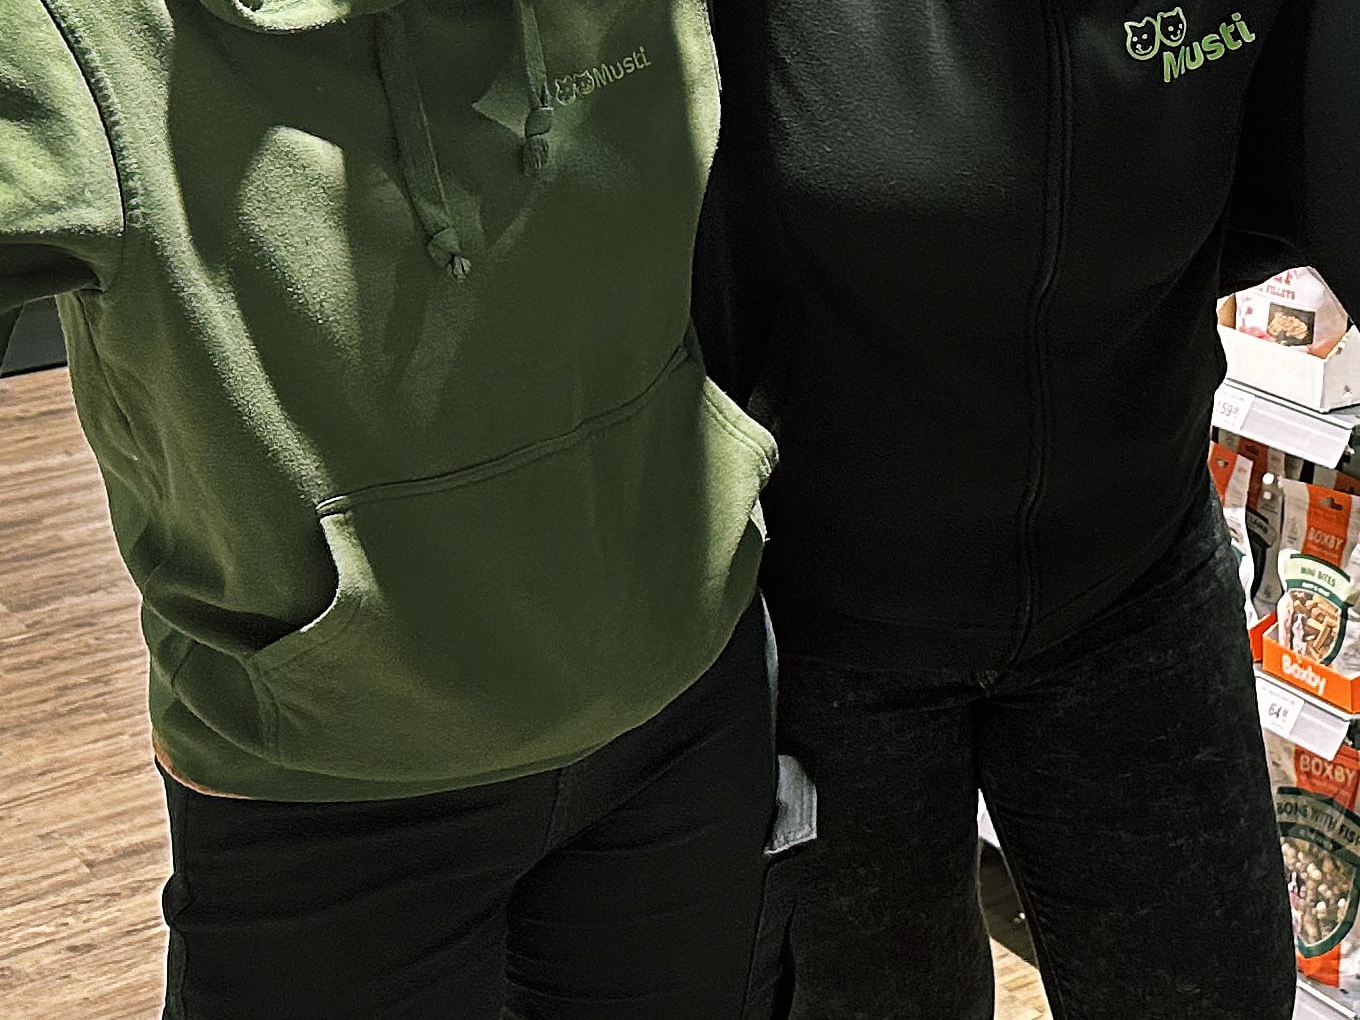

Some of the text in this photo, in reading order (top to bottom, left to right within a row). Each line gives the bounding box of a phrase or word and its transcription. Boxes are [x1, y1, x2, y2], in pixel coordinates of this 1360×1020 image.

[1163, 11, 1256, 83] Musti
[593, 45, 652, 89] Musti
[1308, 526, 1344, 551] BOXBY
[1300, 754, 1356, 789] BOXBY
